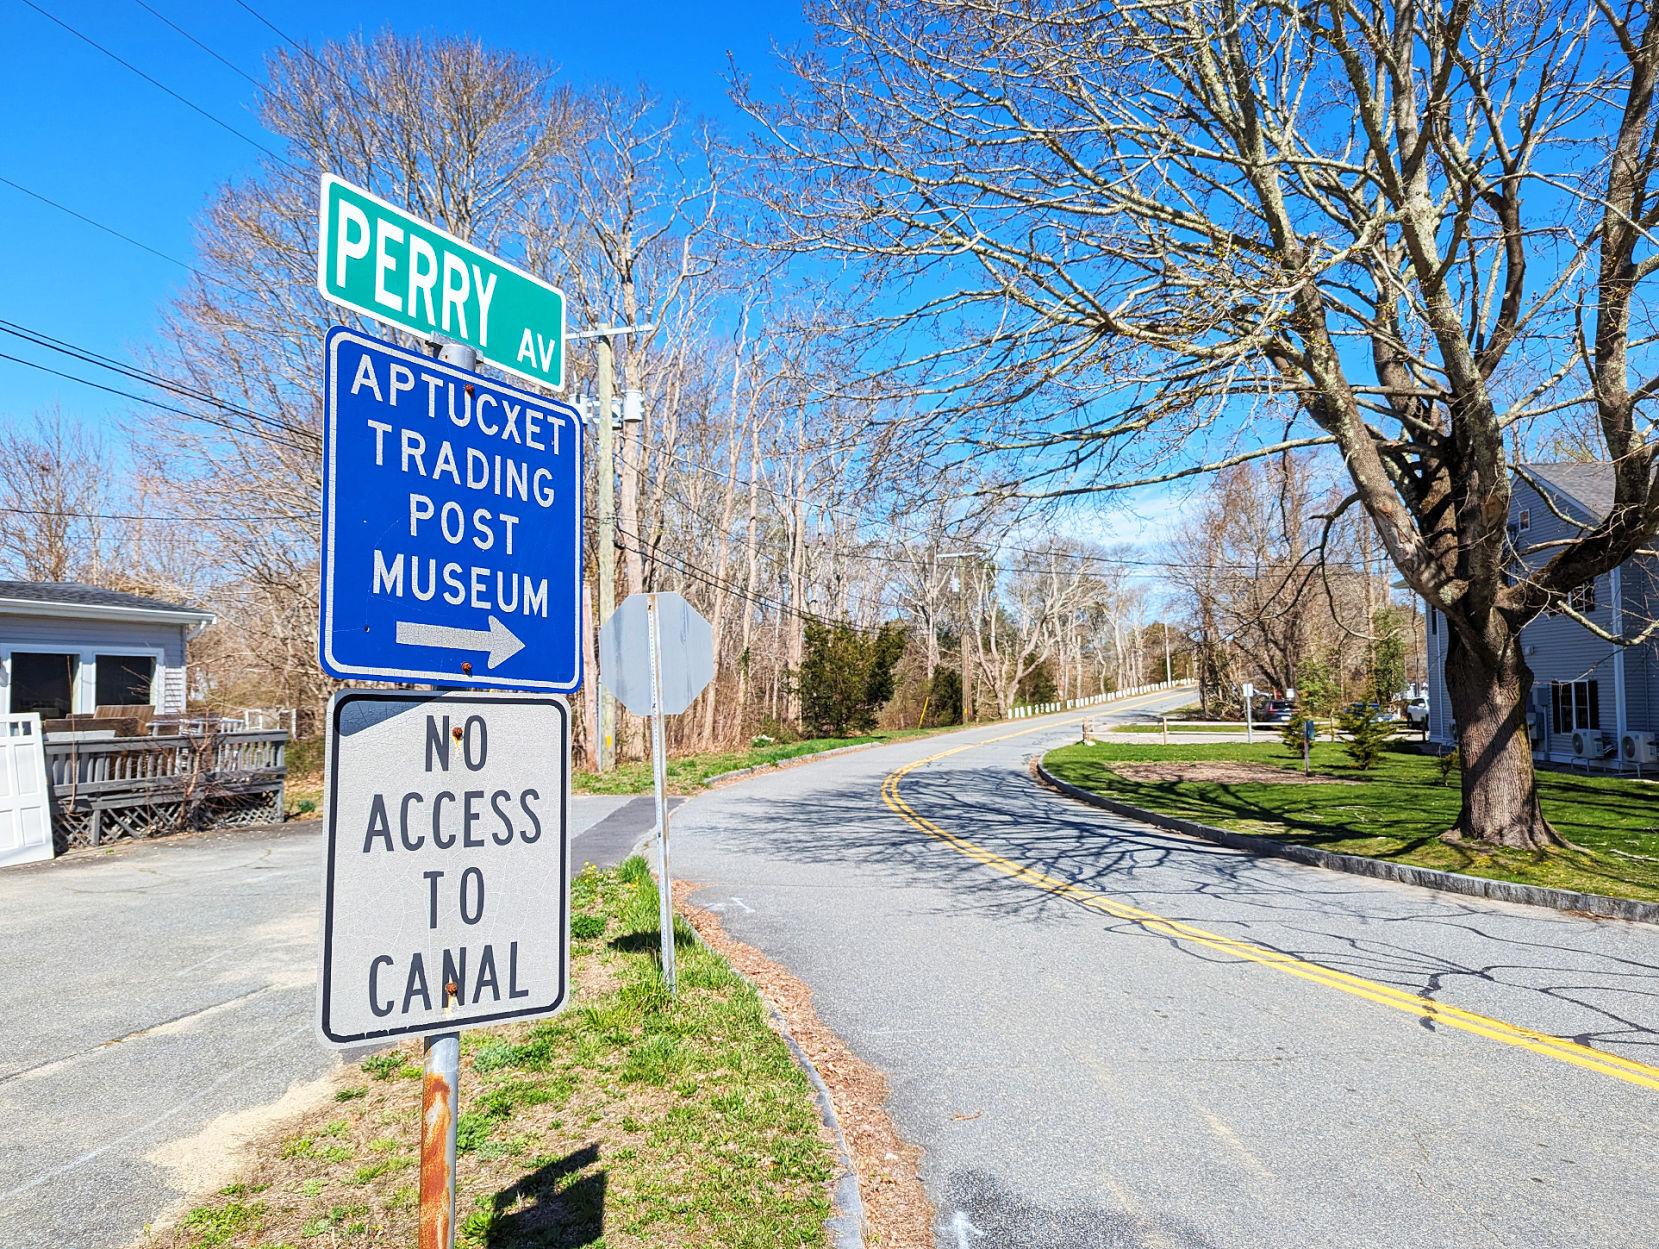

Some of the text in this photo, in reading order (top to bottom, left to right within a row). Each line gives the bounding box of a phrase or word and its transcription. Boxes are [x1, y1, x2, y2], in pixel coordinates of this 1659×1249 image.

[337, 199, 555, 373] PERRY AV
[351, 354, 566, 455] APTUCXET
[368, 420, 555, 508] TRADING
[410, 493, 519, 555] POST
[373, 549, 548, 618] MUSEUM
[425, 715, 488, 772] NO
[363, 788, 542, 853] ACCESS
[423, 867, 485, 929] TO
[369, 941, 529, 1018] CANAL
